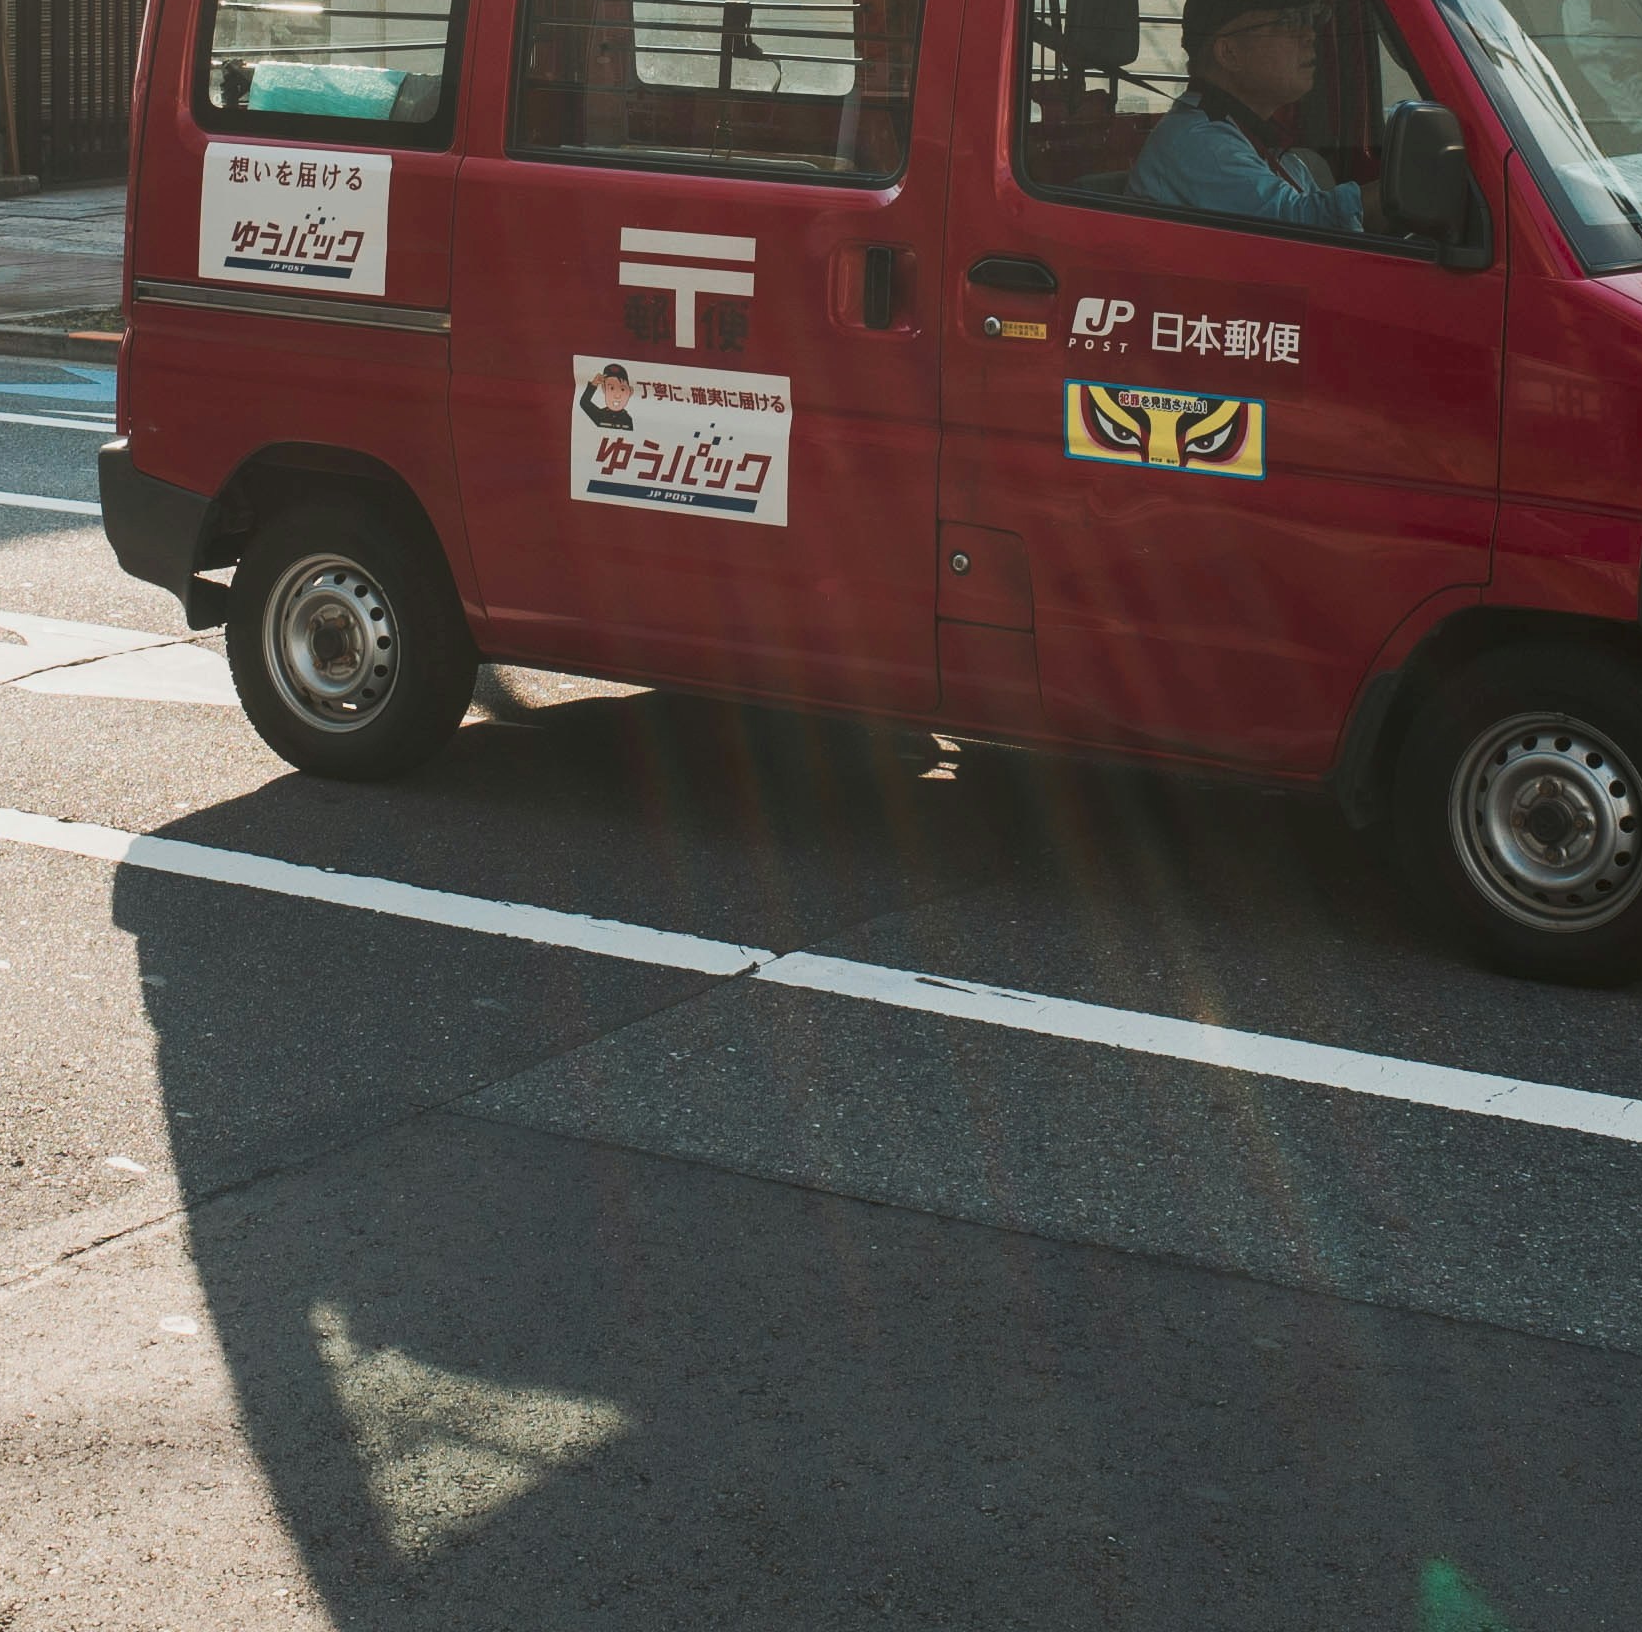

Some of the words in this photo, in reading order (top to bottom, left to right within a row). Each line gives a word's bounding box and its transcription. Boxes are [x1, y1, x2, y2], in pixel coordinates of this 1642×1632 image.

[229, 156, 363, 191] 想いを届ける
[231, 220, 365, 263] ゆうパック
[269, 262, 280, 270] JP
[281, 264, 306, 272] POST
[1071, 297, 1135, 337] JP
[1068, 337, 1130, 354] POST
[1152, 311, 1300, 364] 日本郵便
[636, 381, 786, 414] 丁寧に、確実に届ける
[596, 436, 772, 494] ゆうパック
[646, 490, 662, 499] JP
[664, 492, 696, 503] POST
